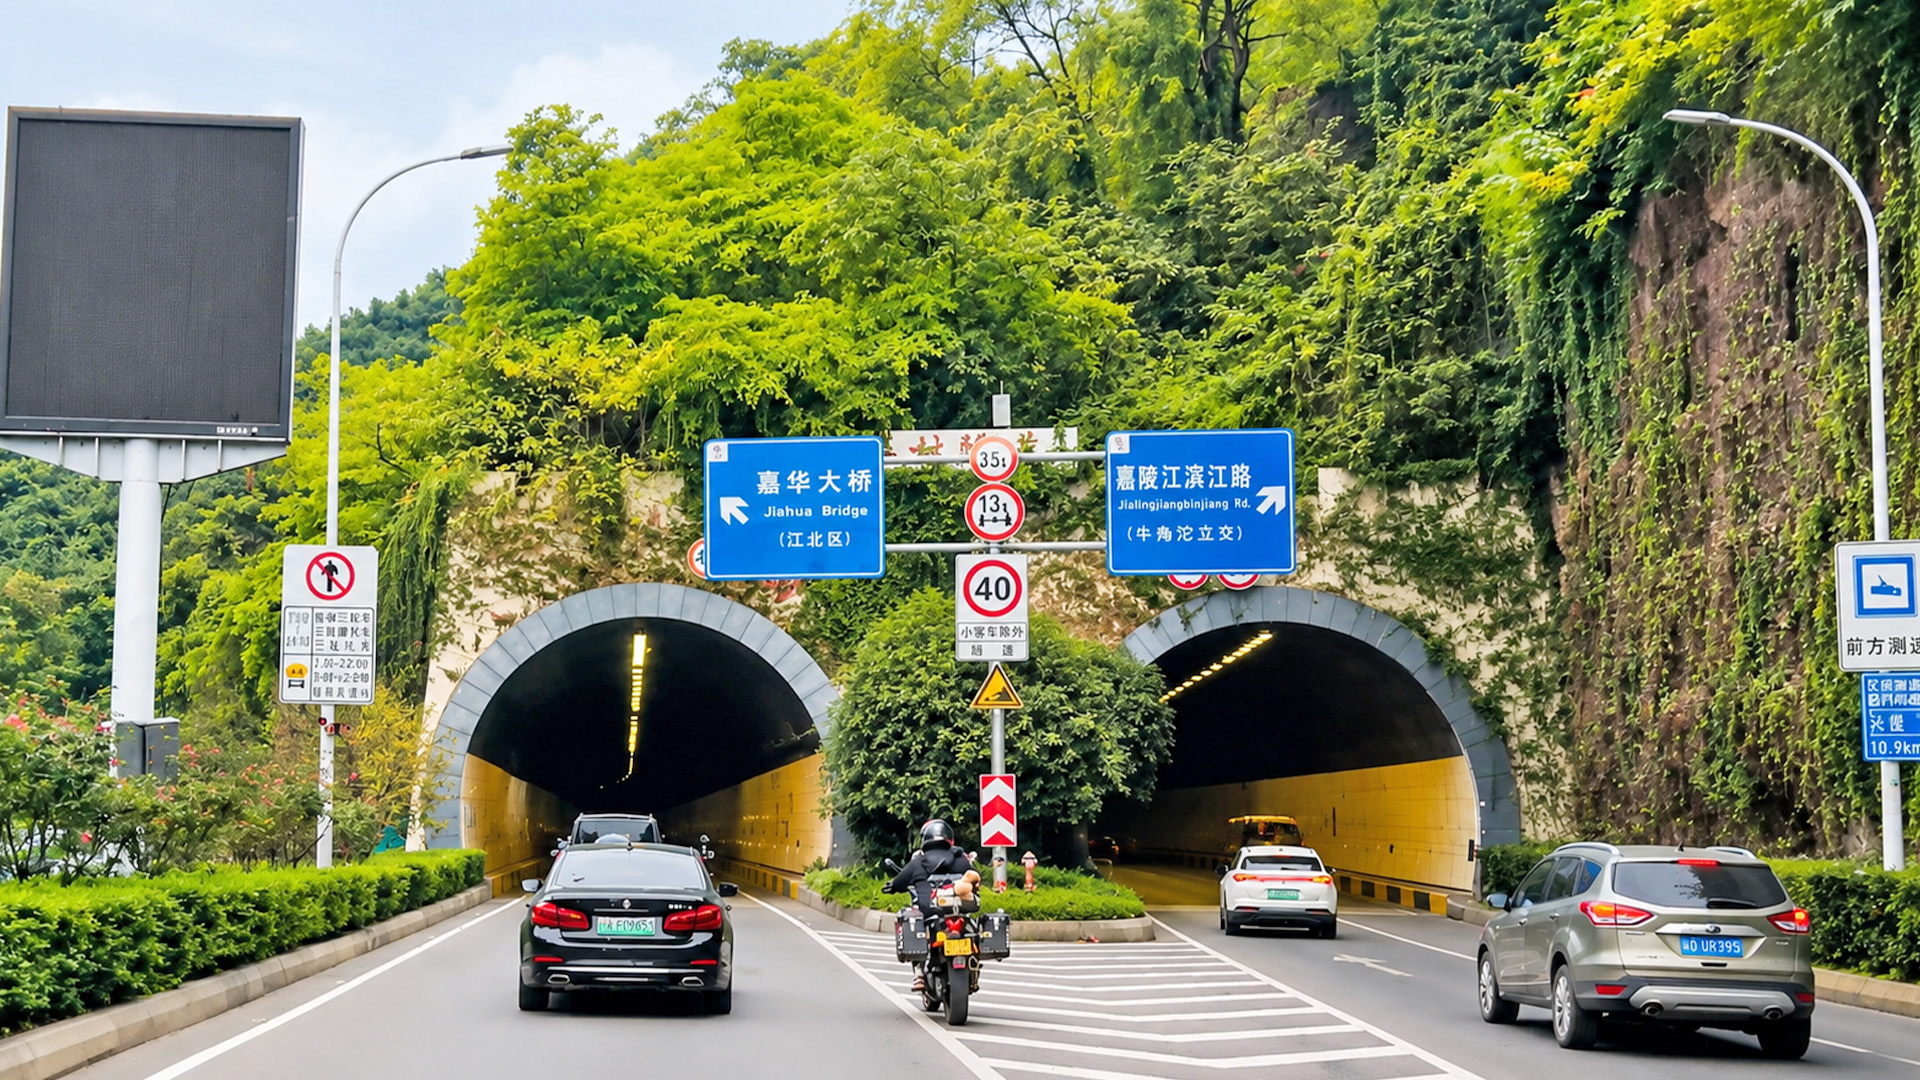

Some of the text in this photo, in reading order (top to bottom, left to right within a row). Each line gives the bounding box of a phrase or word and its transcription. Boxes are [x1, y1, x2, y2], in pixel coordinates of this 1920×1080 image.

[756, 469, 872, 495] 嘉华大桥
[1115, 463, 1251, 491] 嘉陵江滨江路
[764, 505, 868, 519] Jiahua Bridge
[1117, 498, 1251, 511] Jialingjiangbinjiang Rd.
[975, 576, 1011, 601] 40
